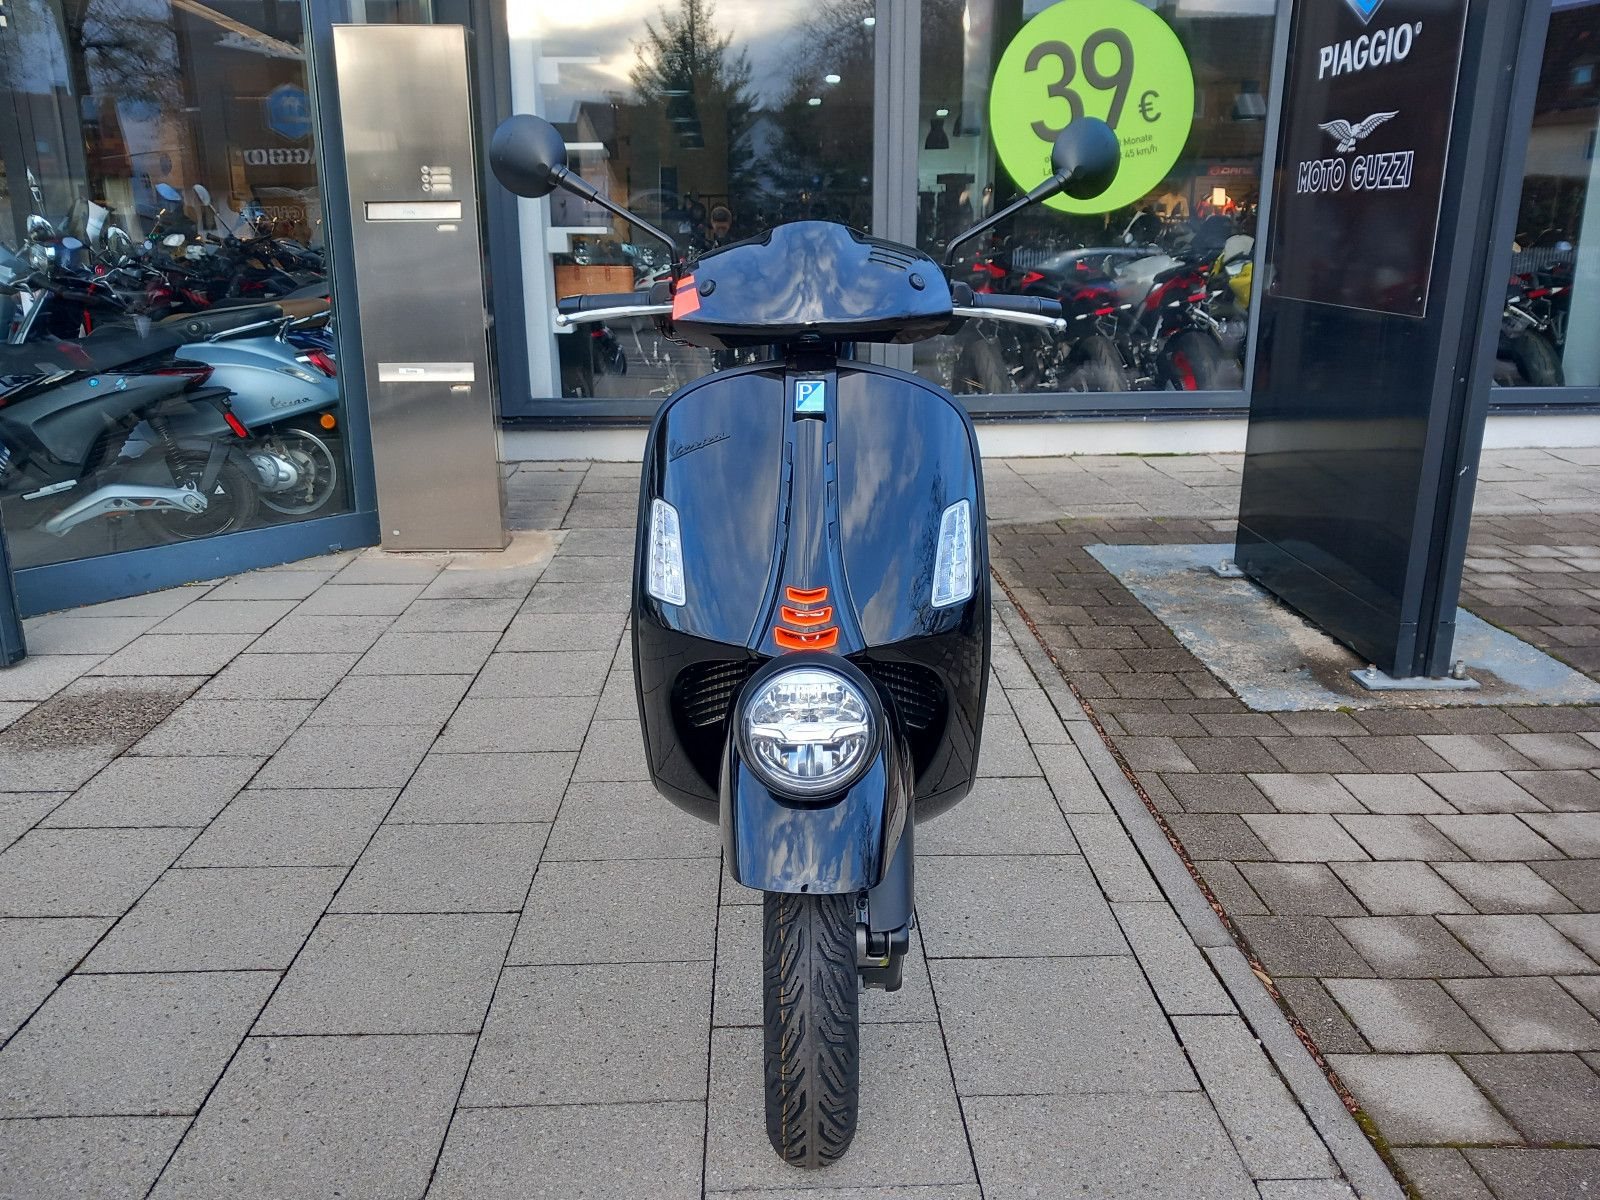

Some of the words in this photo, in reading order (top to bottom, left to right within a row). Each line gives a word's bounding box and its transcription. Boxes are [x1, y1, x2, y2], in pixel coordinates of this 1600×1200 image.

[1024, 28, 1135, 143] 39
[1138, 90, 1161, 123] €
[1123, 134, 1153, 146] Monate
[1125, 150, 1135, 159] 45
[1136, 143, 1158, 156] km/h
[1297, 158, 1346, 193] MOTO
[1351, 150, 1414, 190] GUZZI
